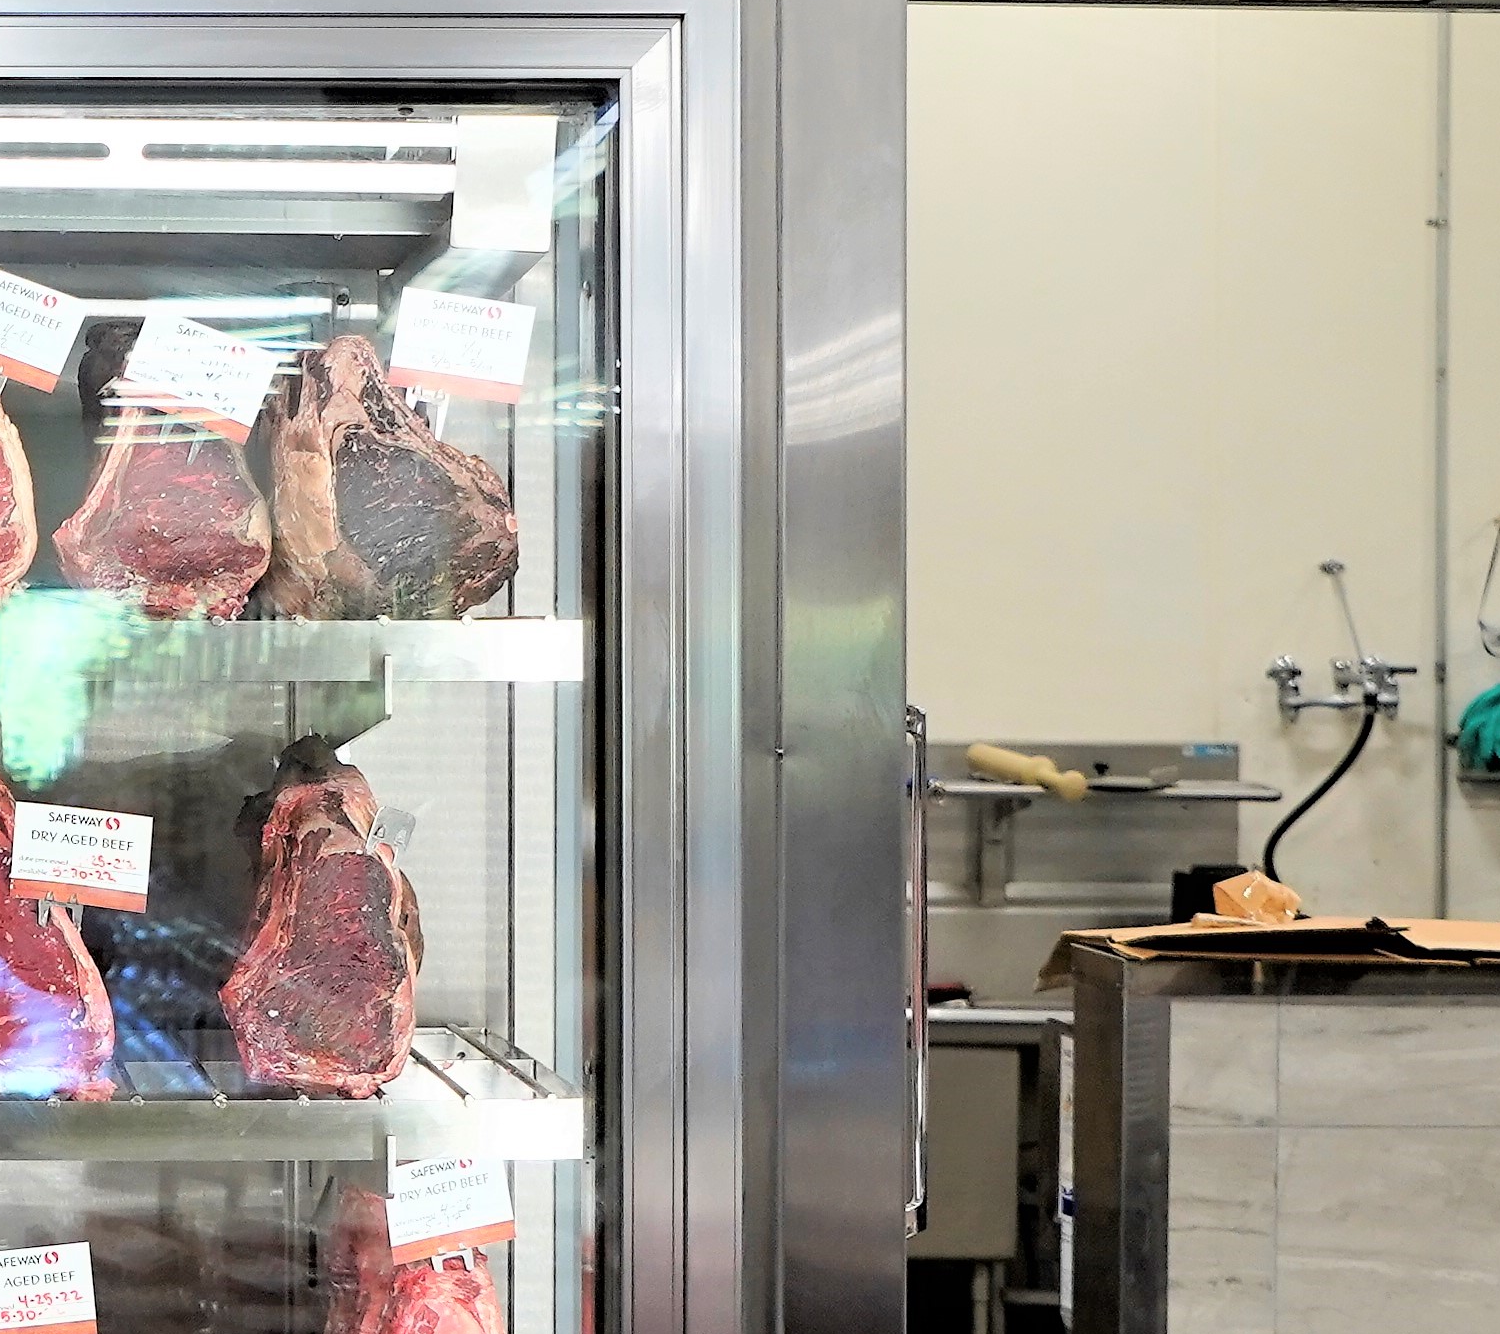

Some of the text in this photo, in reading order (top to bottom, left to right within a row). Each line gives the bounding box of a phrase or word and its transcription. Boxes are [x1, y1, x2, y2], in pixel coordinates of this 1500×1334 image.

[33, 313, 64, 332] BEEF
[49, 811, 104, 828] SAFEWAY
[31, 829, 136, 853] DRY AGED BEEF
[410, 1159, 457, 1180] SAFEWAY
[400, 1172, 489, 1204] DRY AGED BEEF
[4, 1274, 41, 1290] AGED
[44, 1270, 77, 1285] BEEF
